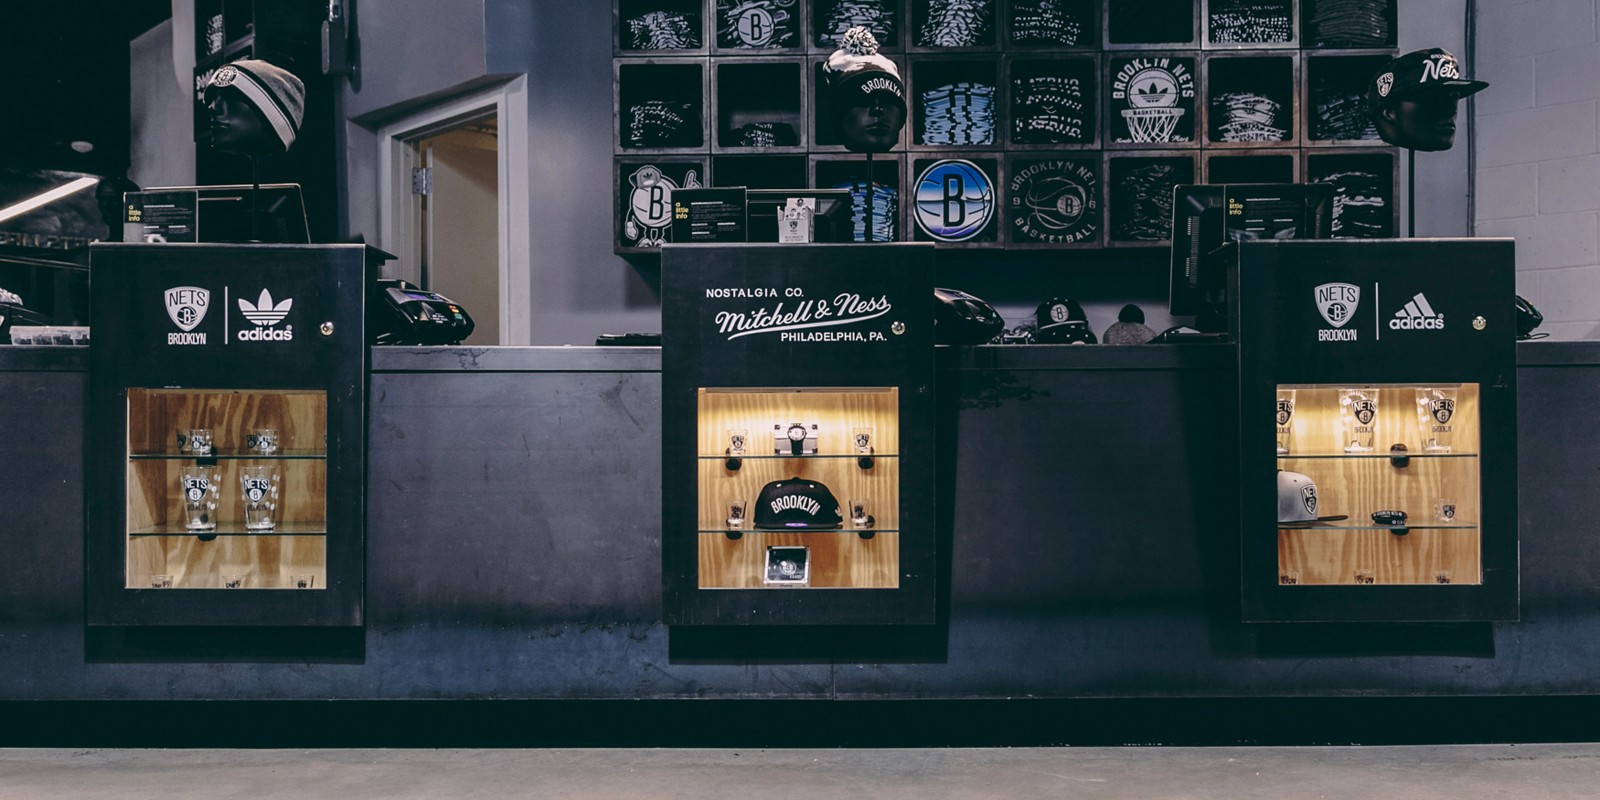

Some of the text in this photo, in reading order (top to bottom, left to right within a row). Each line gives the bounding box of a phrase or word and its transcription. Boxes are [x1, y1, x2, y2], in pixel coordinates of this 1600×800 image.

[751, 13, 762, 41] B
[1420, 58, 1460, 83] Nets
[861, 78, 902, 97] BROOKLYN
[1172, 64, 1195, 99] NETS
[1011, 161, 1074, 191] BROOKLYN
[649, 186, 664, 220] B
[943, 173, 966, 227] B
[1015, 217, 1096, 244] BASKETBALL
[169, 290, 206, 307] NETS
[706, 288, 804, 298] NOSTALGIA CO.
[1319, 286, 1356, 303] NETS
[715, 293, 891, 333] Mitchell & Ness
[168, 332, 206, 345] BROOKLYN
[781, 332, 887, 342] PHILADELPHIA, PA.
[1318, 329, 1357, 341] BROOKLYN
[1276, 401, 1293, 412] ETS
[1353, 401, 1377, 412] NETS
[1431, 401, 1455, 411] NETS
[184, 480, 208, 489] NETS
[244, 480, 268, 489] NETS
[771, 495, 821, 516] BROOKLYN
